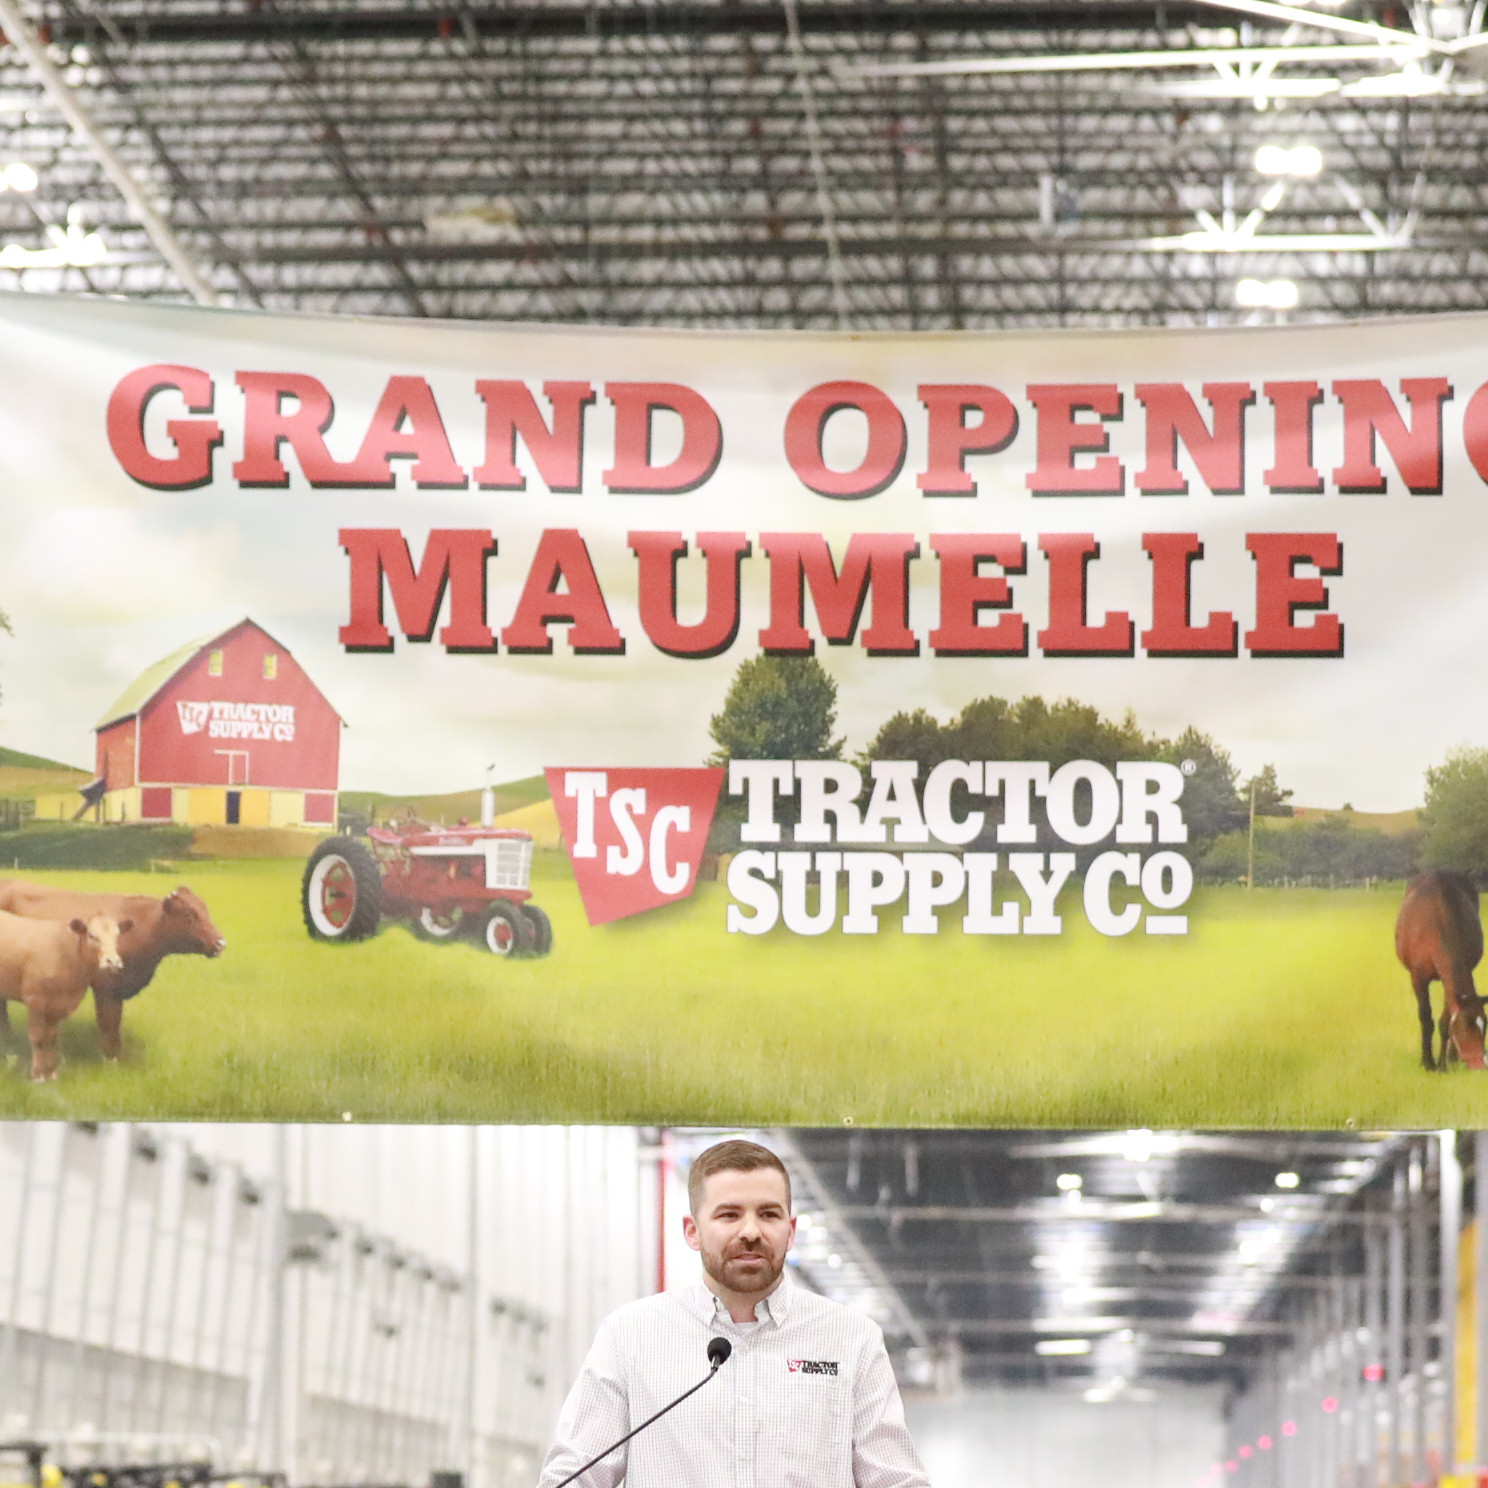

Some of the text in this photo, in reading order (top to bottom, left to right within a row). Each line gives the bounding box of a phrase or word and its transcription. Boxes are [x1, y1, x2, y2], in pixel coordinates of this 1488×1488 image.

[106, 363, 723, 494] GRAND
[338, 528, 1344, 659] MAUMELLE
[209, 720, 271, 740] SUPPLY
[211, 701, 295, 722] TRACTOR
[563, 770, 691, 896] TSC
[728, 759, 1189, 845] TRACTOR
[726, 850, 1076, 936] SUPPLY
